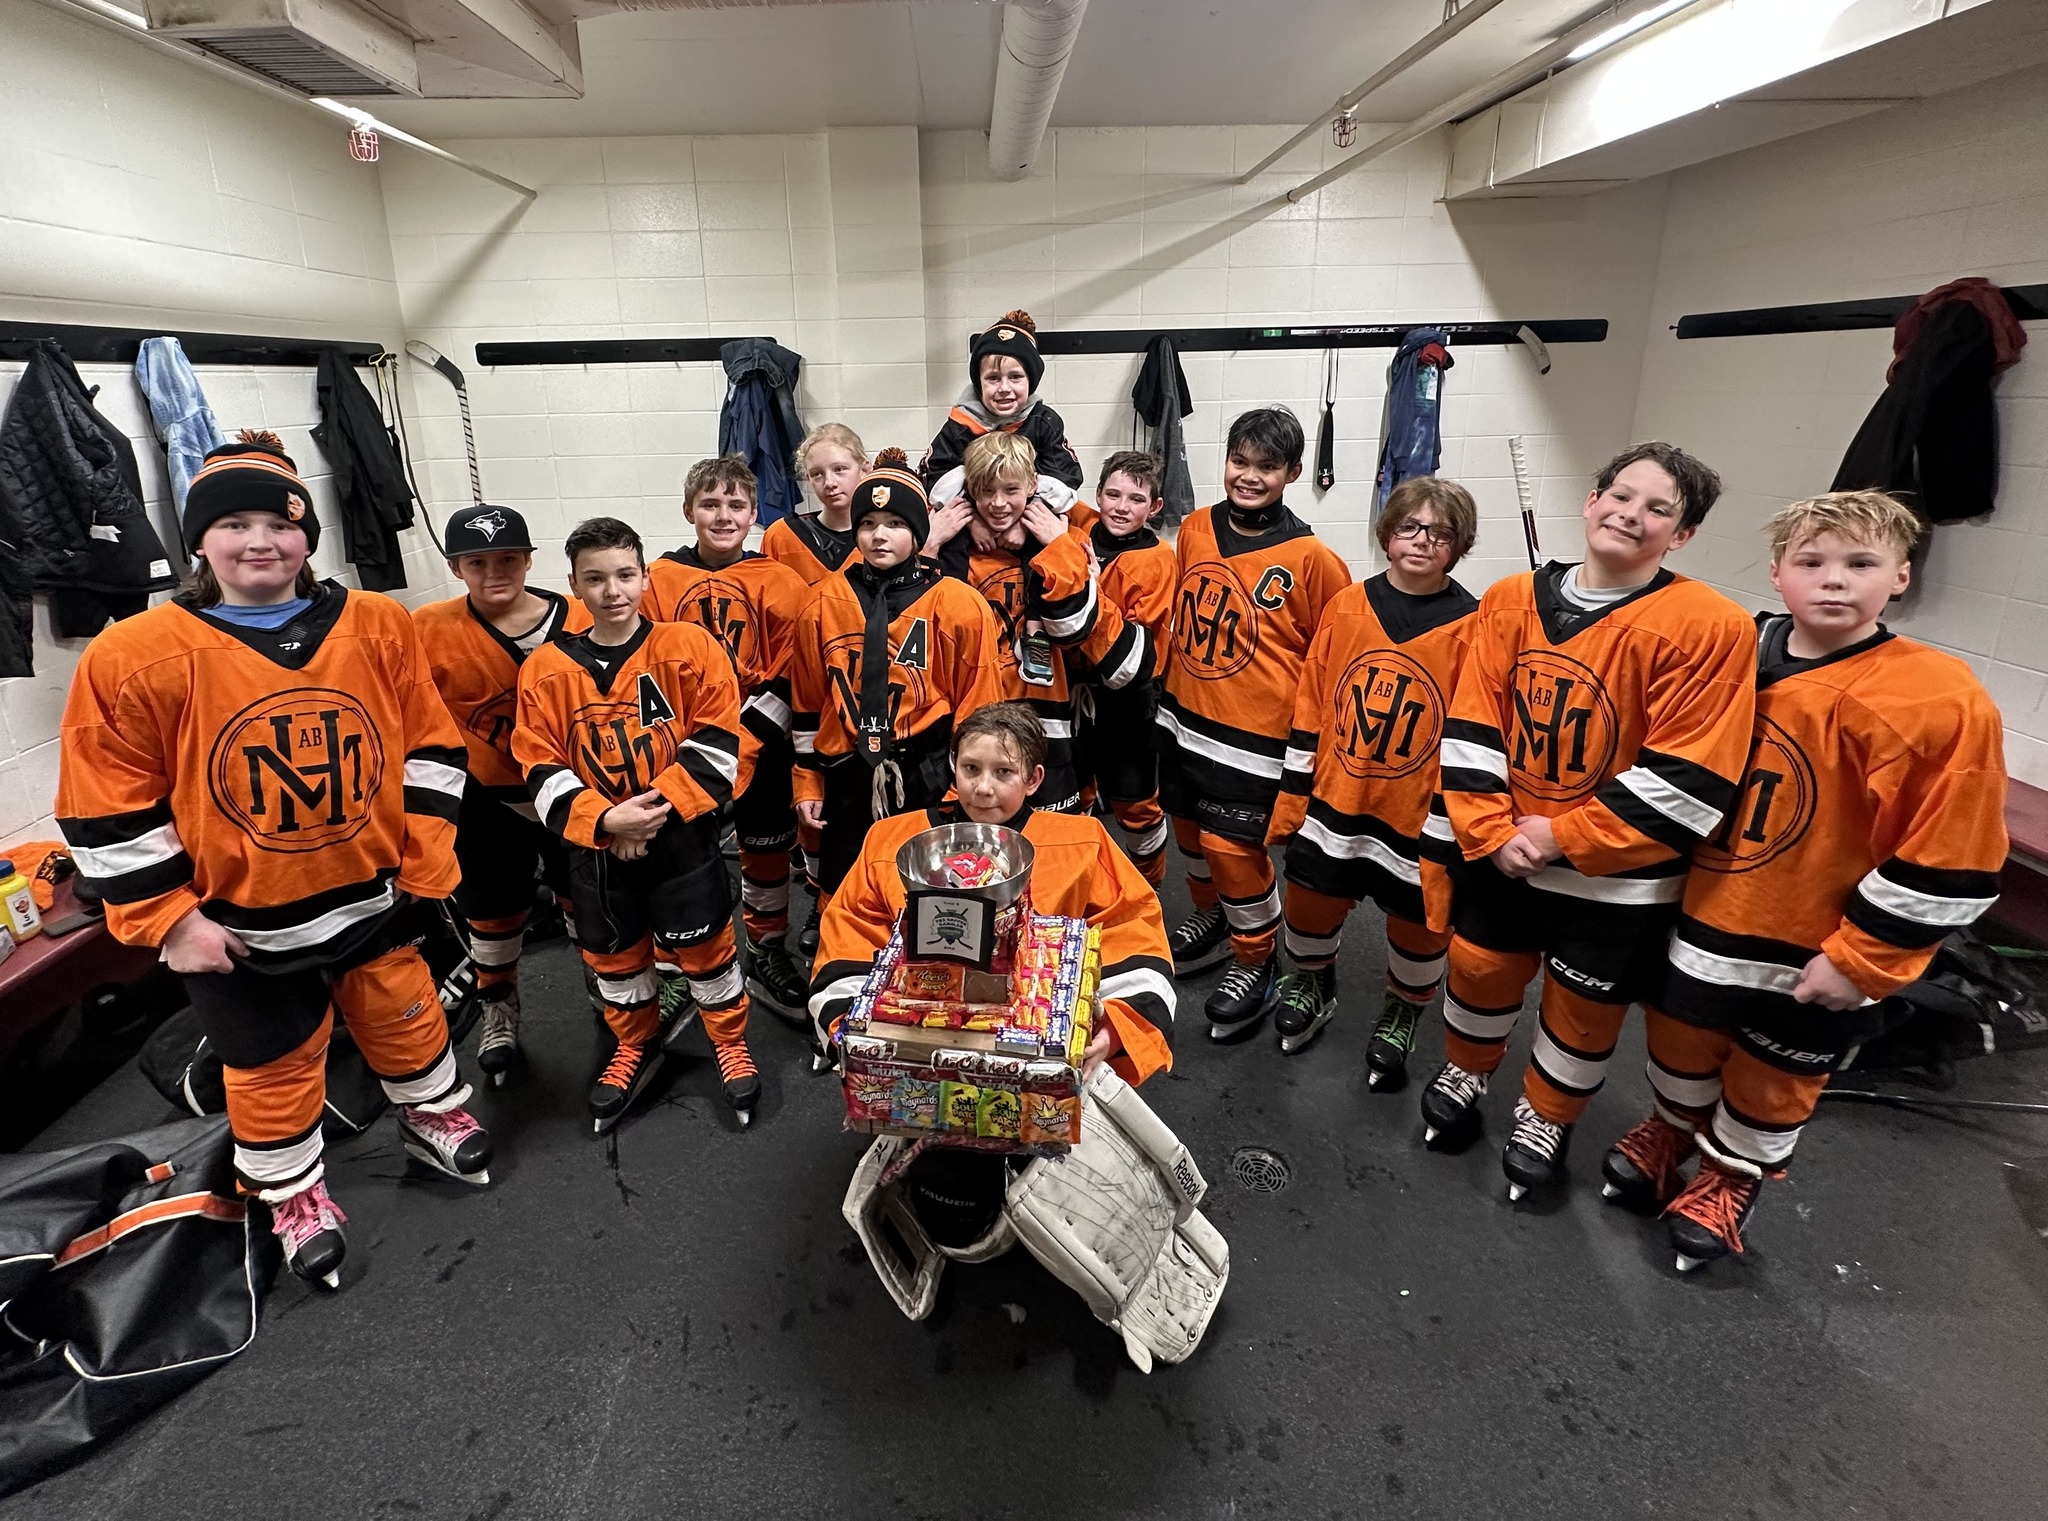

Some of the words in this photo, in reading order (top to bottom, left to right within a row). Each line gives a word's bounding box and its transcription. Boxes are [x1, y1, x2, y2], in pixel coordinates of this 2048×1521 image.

[1345, 326, 1399, 334] JETSPEED
[1252, 565, 1294, 611] C
[1204, 590, 1219, 607] AB
[894, 617, 928, 670] A
[1373, 680, 1394, 698] AB
[1533, 686, 1553, 708] AB
[637, 672, 677, 729] A
[298, 727, 322, 748] AB
[868, 736, 881, 752] 5
[665, 923, 710, 940] CCM
[1550, 956, 1615, 991] CCM
[865, 1063, 911, 1078] Twizzlers
[953, 1110, 976, 1119] PATC
[1031, 1111, 1070, 1128] Maynards
[1173, 1157, 1201, 1201] Reebok
